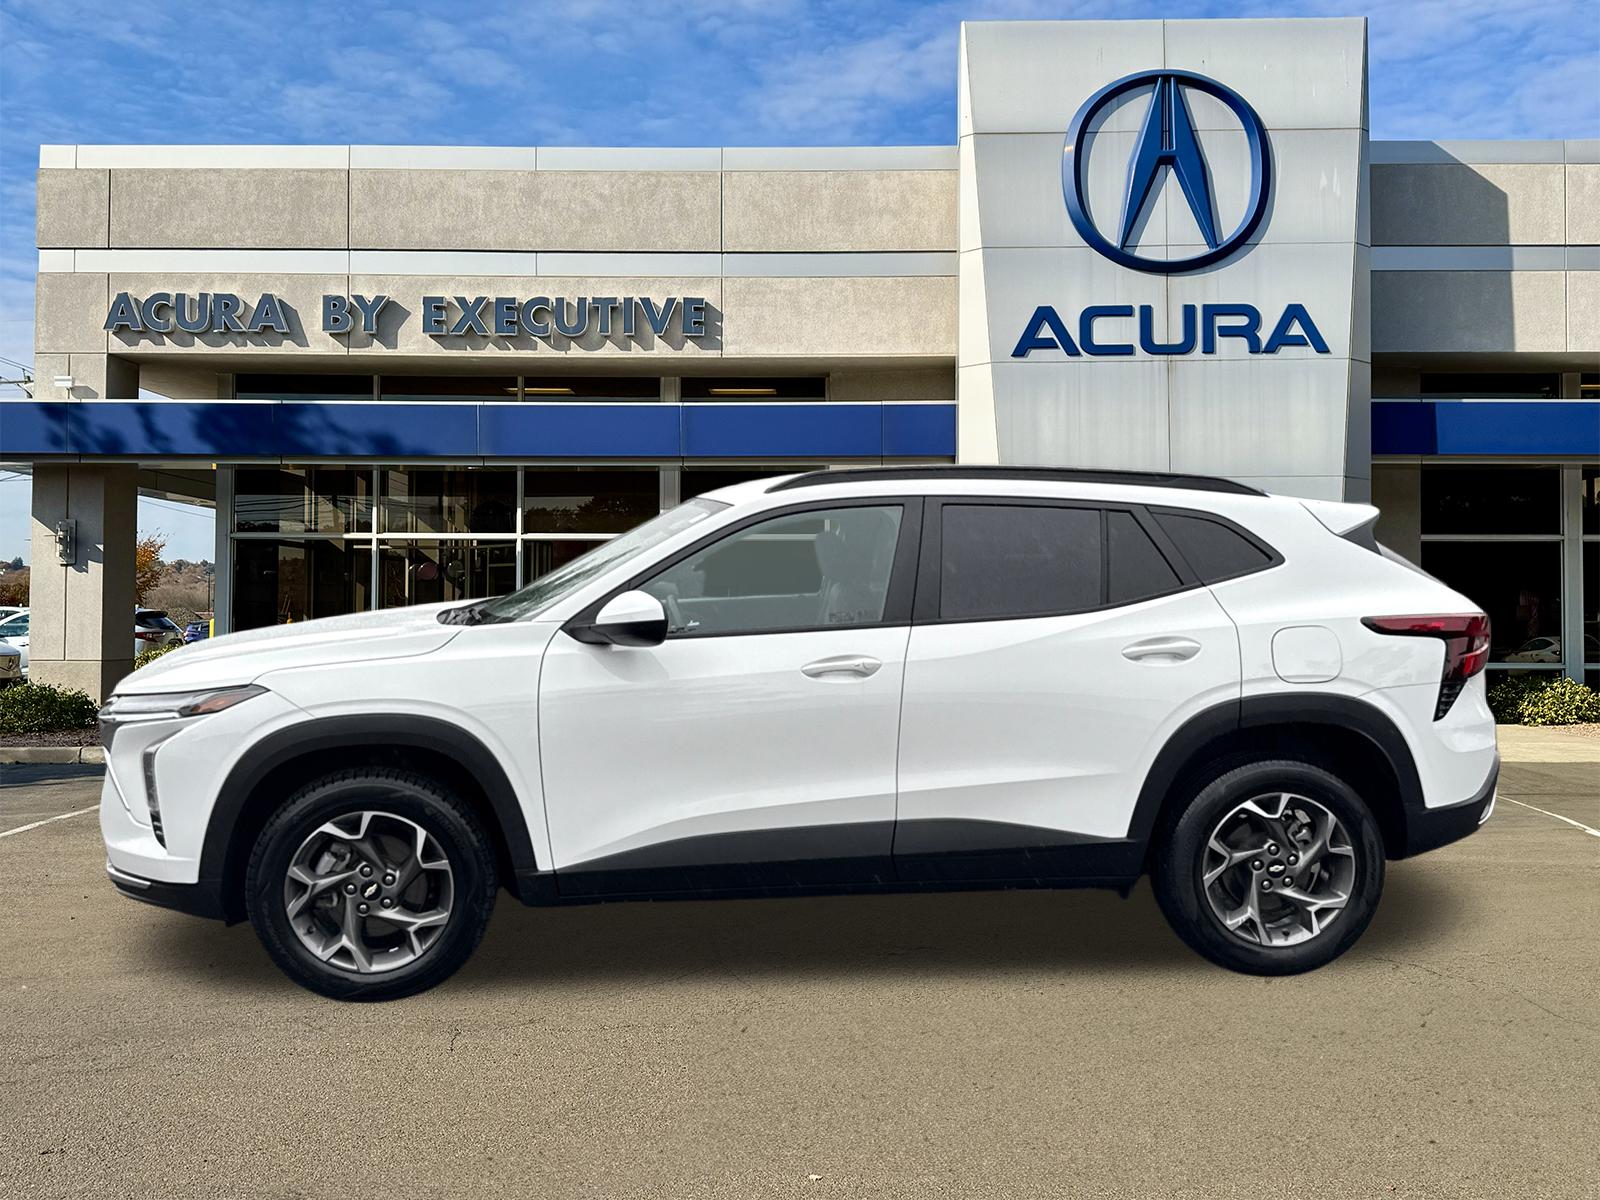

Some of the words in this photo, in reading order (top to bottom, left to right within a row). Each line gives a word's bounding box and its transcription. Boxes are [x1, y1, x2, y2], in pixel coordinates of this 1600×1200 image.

[103, 292, 290, 333] ACURA
[323, 295, 393, 334] BY
[421, 296, 706, 337] EXECUTIVE
[1011, 303, 1331, 357] ACURA
